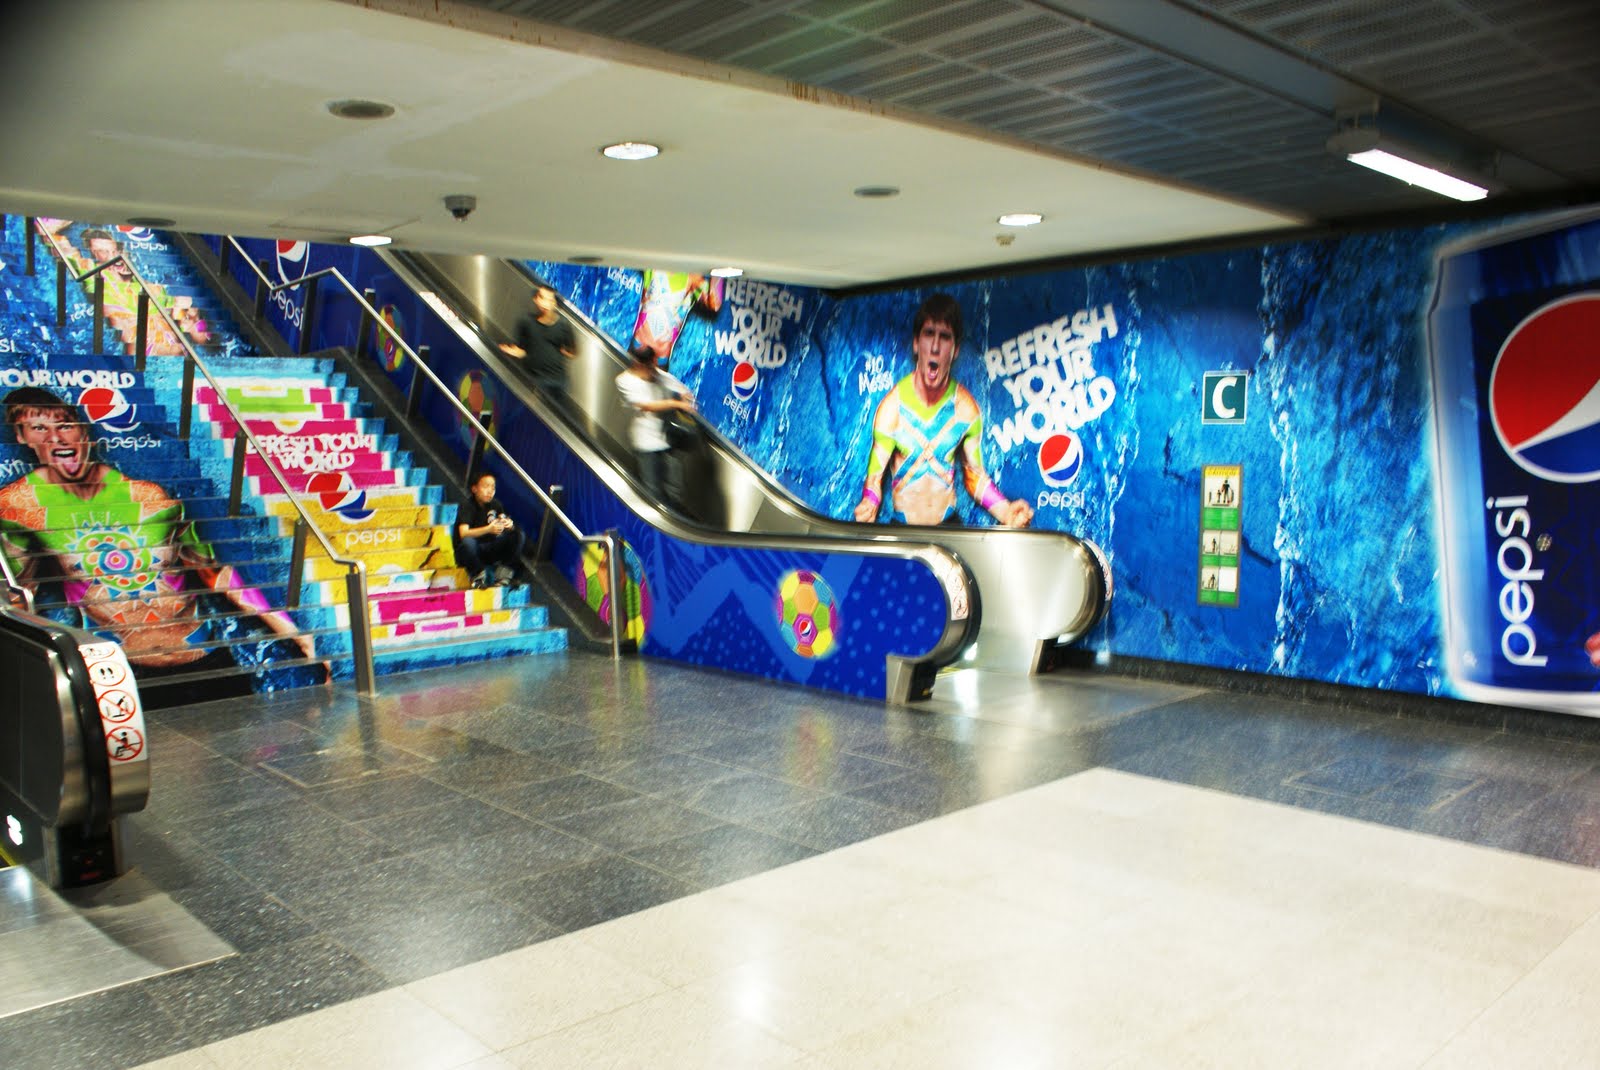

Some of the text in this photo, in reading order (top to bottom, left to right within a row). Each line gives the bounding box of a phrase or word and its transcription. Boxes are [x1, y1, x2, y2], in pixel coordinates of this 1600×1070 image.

[268, 280, 304, 332] pepsi
[725, 278, 804, 324] REFRESH
[731, 303, 783, 341] YOUR
[984, 303, 1119, 381] REFRESH
[715, 329, 787, 370] WORLD
[55, 369, 136, 388] WORLD
[1003, 349, 1097, 408] YOUR
[1212, 376, 1238, 419] C
[722, 394, 752, 421] pepsi
[990, 375, 1117, 453] WORLD
[278, 452, 355, 473] WORLD
[317, 432, 371, 452] YOUR
[1037, 490, 1085, 511] pepsi
[345, 528, 401, 550] pepsi
[1486, 494, 1549, 667] pepsi
